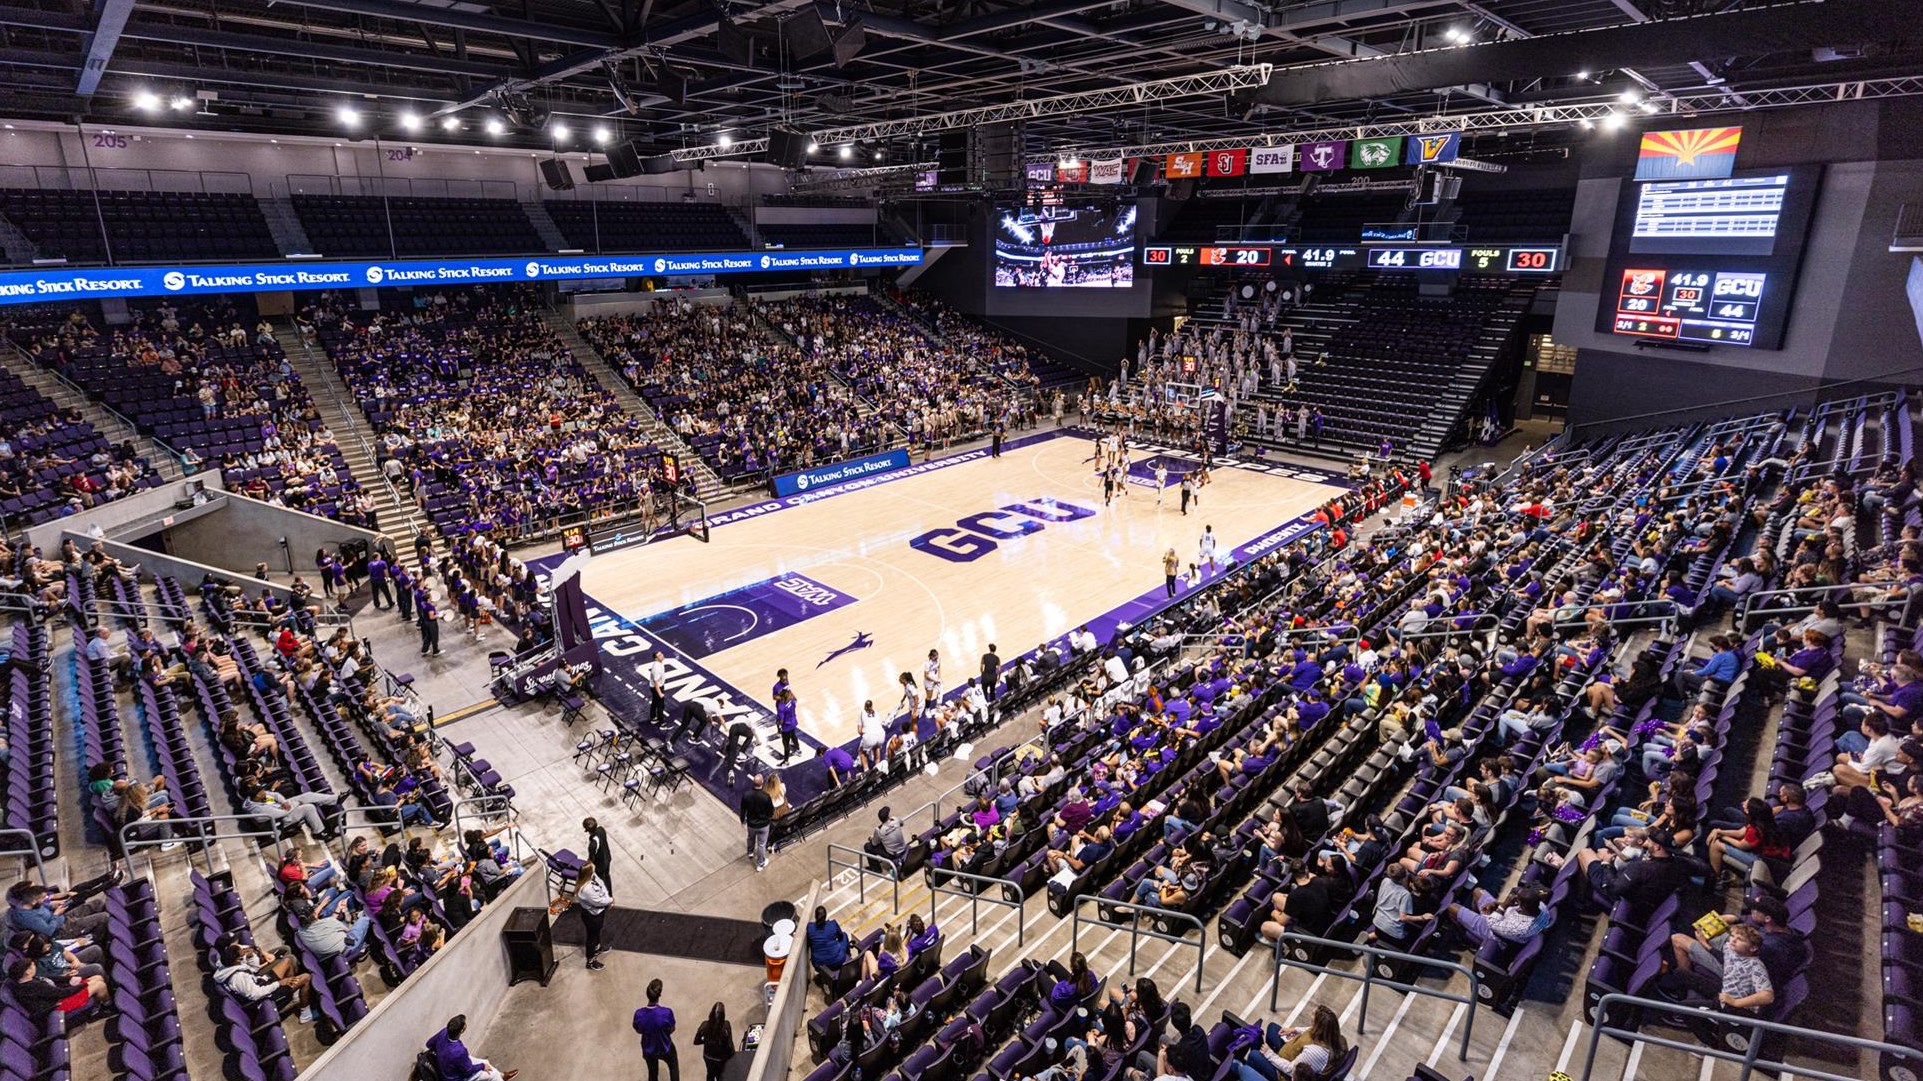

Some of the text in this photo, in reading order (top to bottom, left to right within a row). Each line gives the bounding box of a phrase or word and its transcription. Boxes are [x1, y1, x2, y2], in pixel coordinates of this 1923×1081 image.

[93, 134, 127, 149] 205
[388, 149, 412, 161] 204
[1256, 154, 1279, 166] SFA
[1093, 163, 1120, 177] WAC
[1150, 250, 1166, 262] 30
[1180, 255, 1188, 264] 2
[1236, 250, 1259, 264] 20
[1302, 249, 1336, 261] 41.9
[1377, 251, 1405, 267] 44
[1419, 251, 1461, 267] GCU
[1471, 249, 1500, 257] FOULS
[1517, 252, 1546, 268] 30
[667, 258, 751, 270] TALKING STICK RESORT
[771, 256, 842, 266] TALKING STICK RESORT
[1478, 257, 1488, 268] 5
[384, 266, 512, 280] TALKING STICK RESORT
[540, 262, 643, 275] TALKING STICK RESORT
[38, 279, 75, 294] STICK
[74, 277, 141, 291] RESORT
[187, 271, 349, 287] TALKING STICK RESORT
[1671, 273, 1709, 287] 41.9
[1714, 278, 1763, 297] GCU
[1679, 290, 1696, 300] 30
[1627, 298, 1648, 311] 20
[1719, 304, 1744, 318] 44
[1637, 321, 1648, 331] 2
[665, 464, 676, 482] 30
[808, 459, 892, 485] TALKING STICK RESORT
[692, 502, 782, 530] GRAND
[877, 450, 988, 482] UNIVERSITY
[909, 497, 1097, 563] GCU
[568, 535, 581, 546] 30
